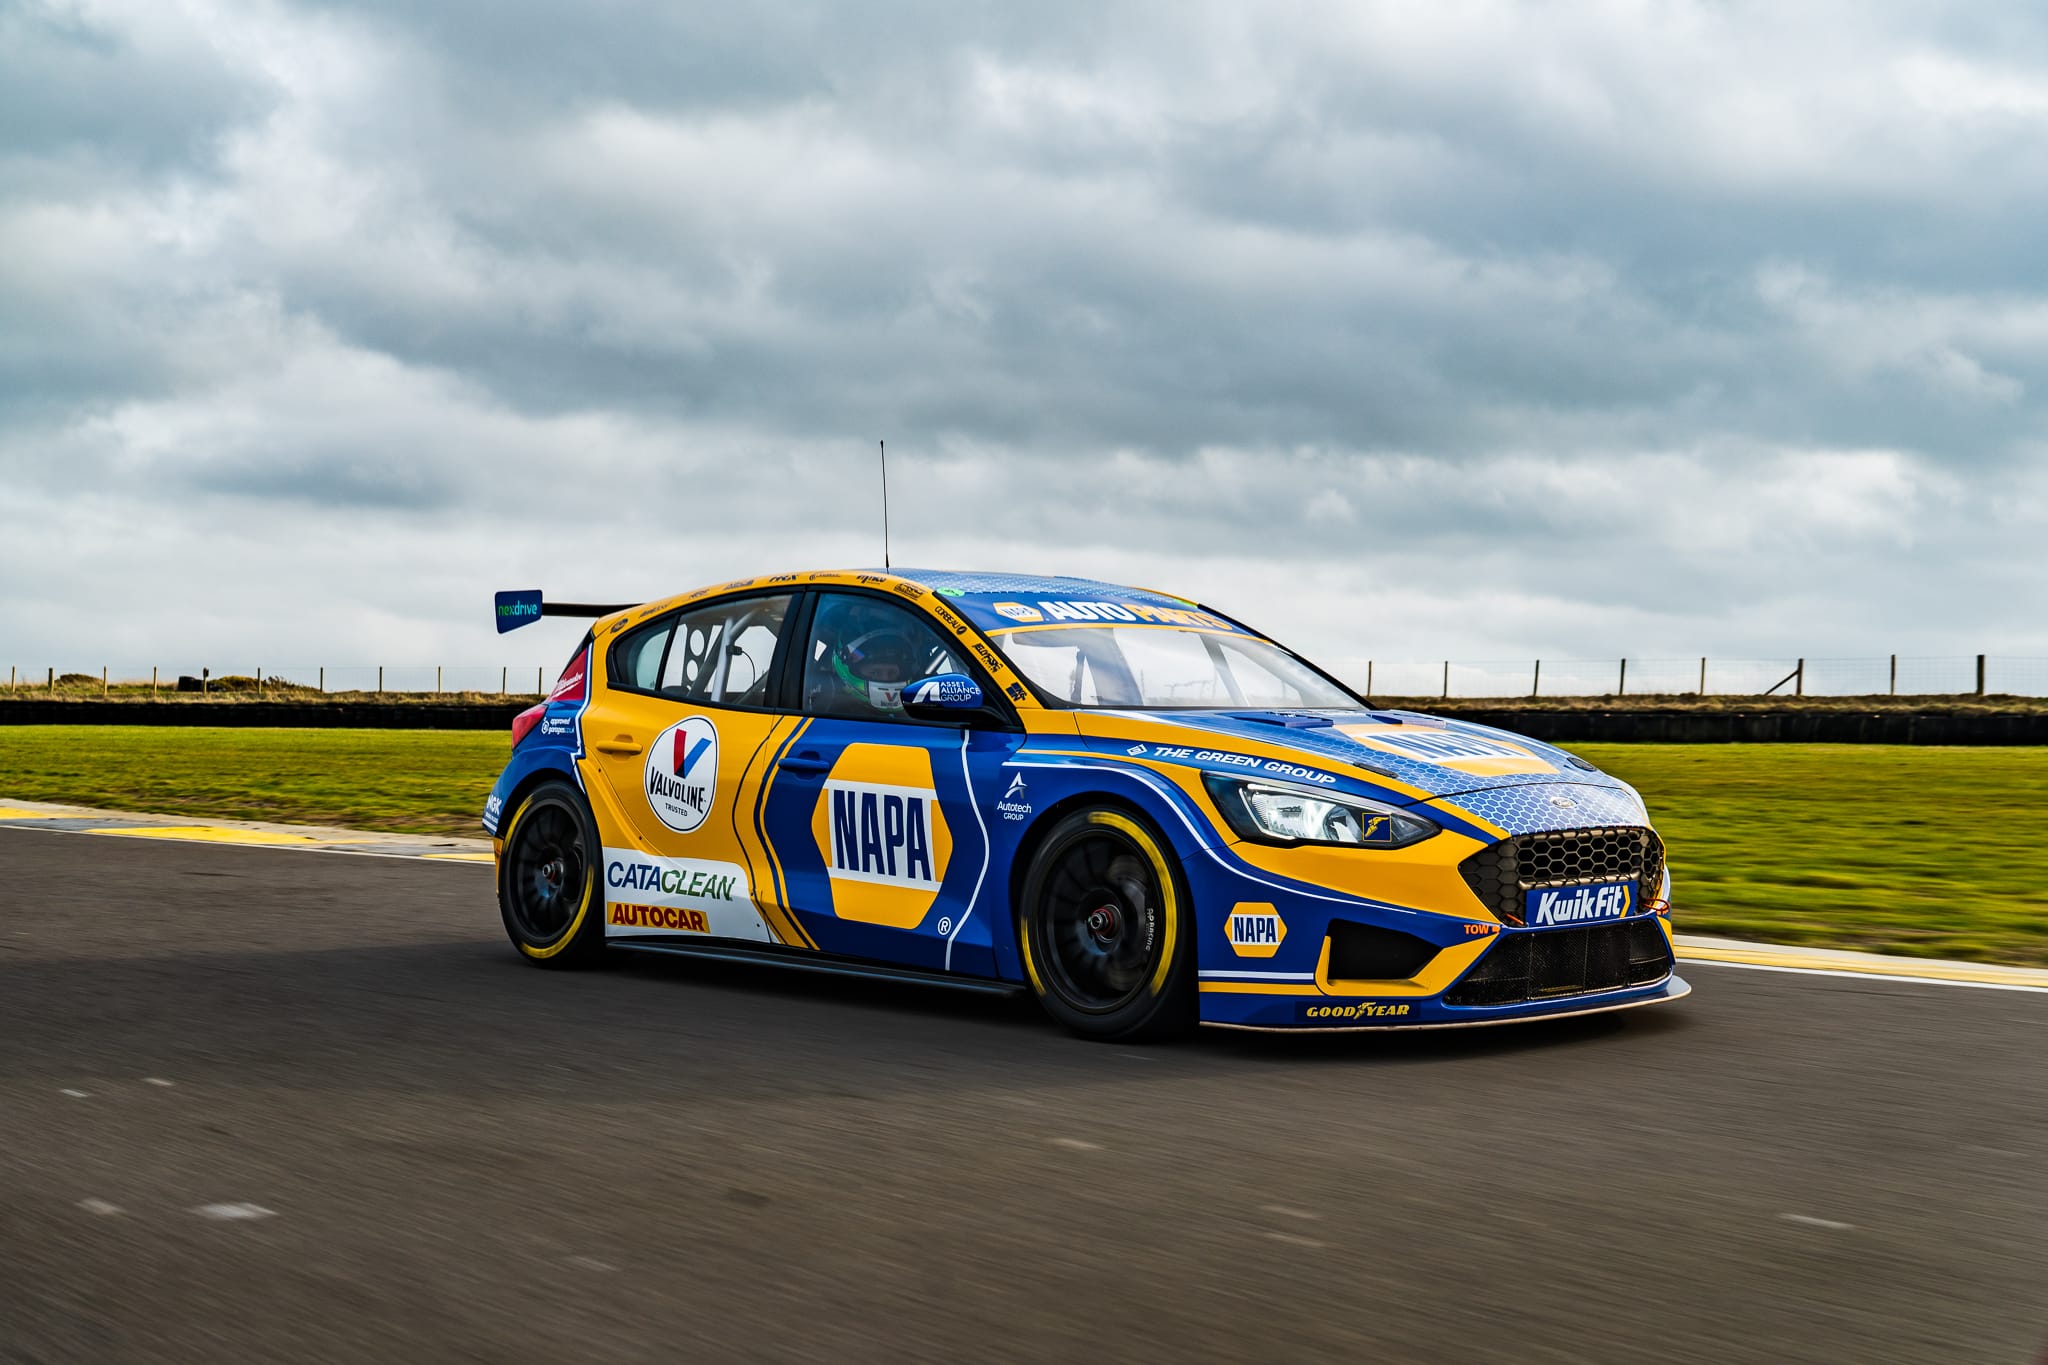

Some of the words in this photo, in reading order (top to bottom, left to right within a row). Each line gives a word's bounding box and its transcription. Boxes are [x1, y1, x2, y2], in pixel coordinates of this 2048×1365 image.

[498, 600, 538, 616] nexdrive
[1037, 601, 1137, 621] AUTO
[1121, 603, 1233, 631] PARTS
[941, 687, 981, 695] ALLIANCE
[941, 694, 972, 702] GROUP
[1154, 746, 1193, 760] THE
[1195, 750, 1261, 768] GREEN
[1264, 761, 1337, 785] GROUP
[650, 766, 706, 815] VALVOLINE
[665, 802, 688, 817] TRUSTED
[997, 800, 1032, 814] Autotech
[1003, 812, 1024, 821] GROUP
[833, 789, 933, 882] NAPA
[607, 861, 737, 902] CATACLEAN
[612, 903, 706, 932] AUTOCAR
[1234, 917, 1277, 943] NAPA
[1464, 924, 1489, 935] TOW
[1306, 1003, 1410, 1019] GOODYEAR
